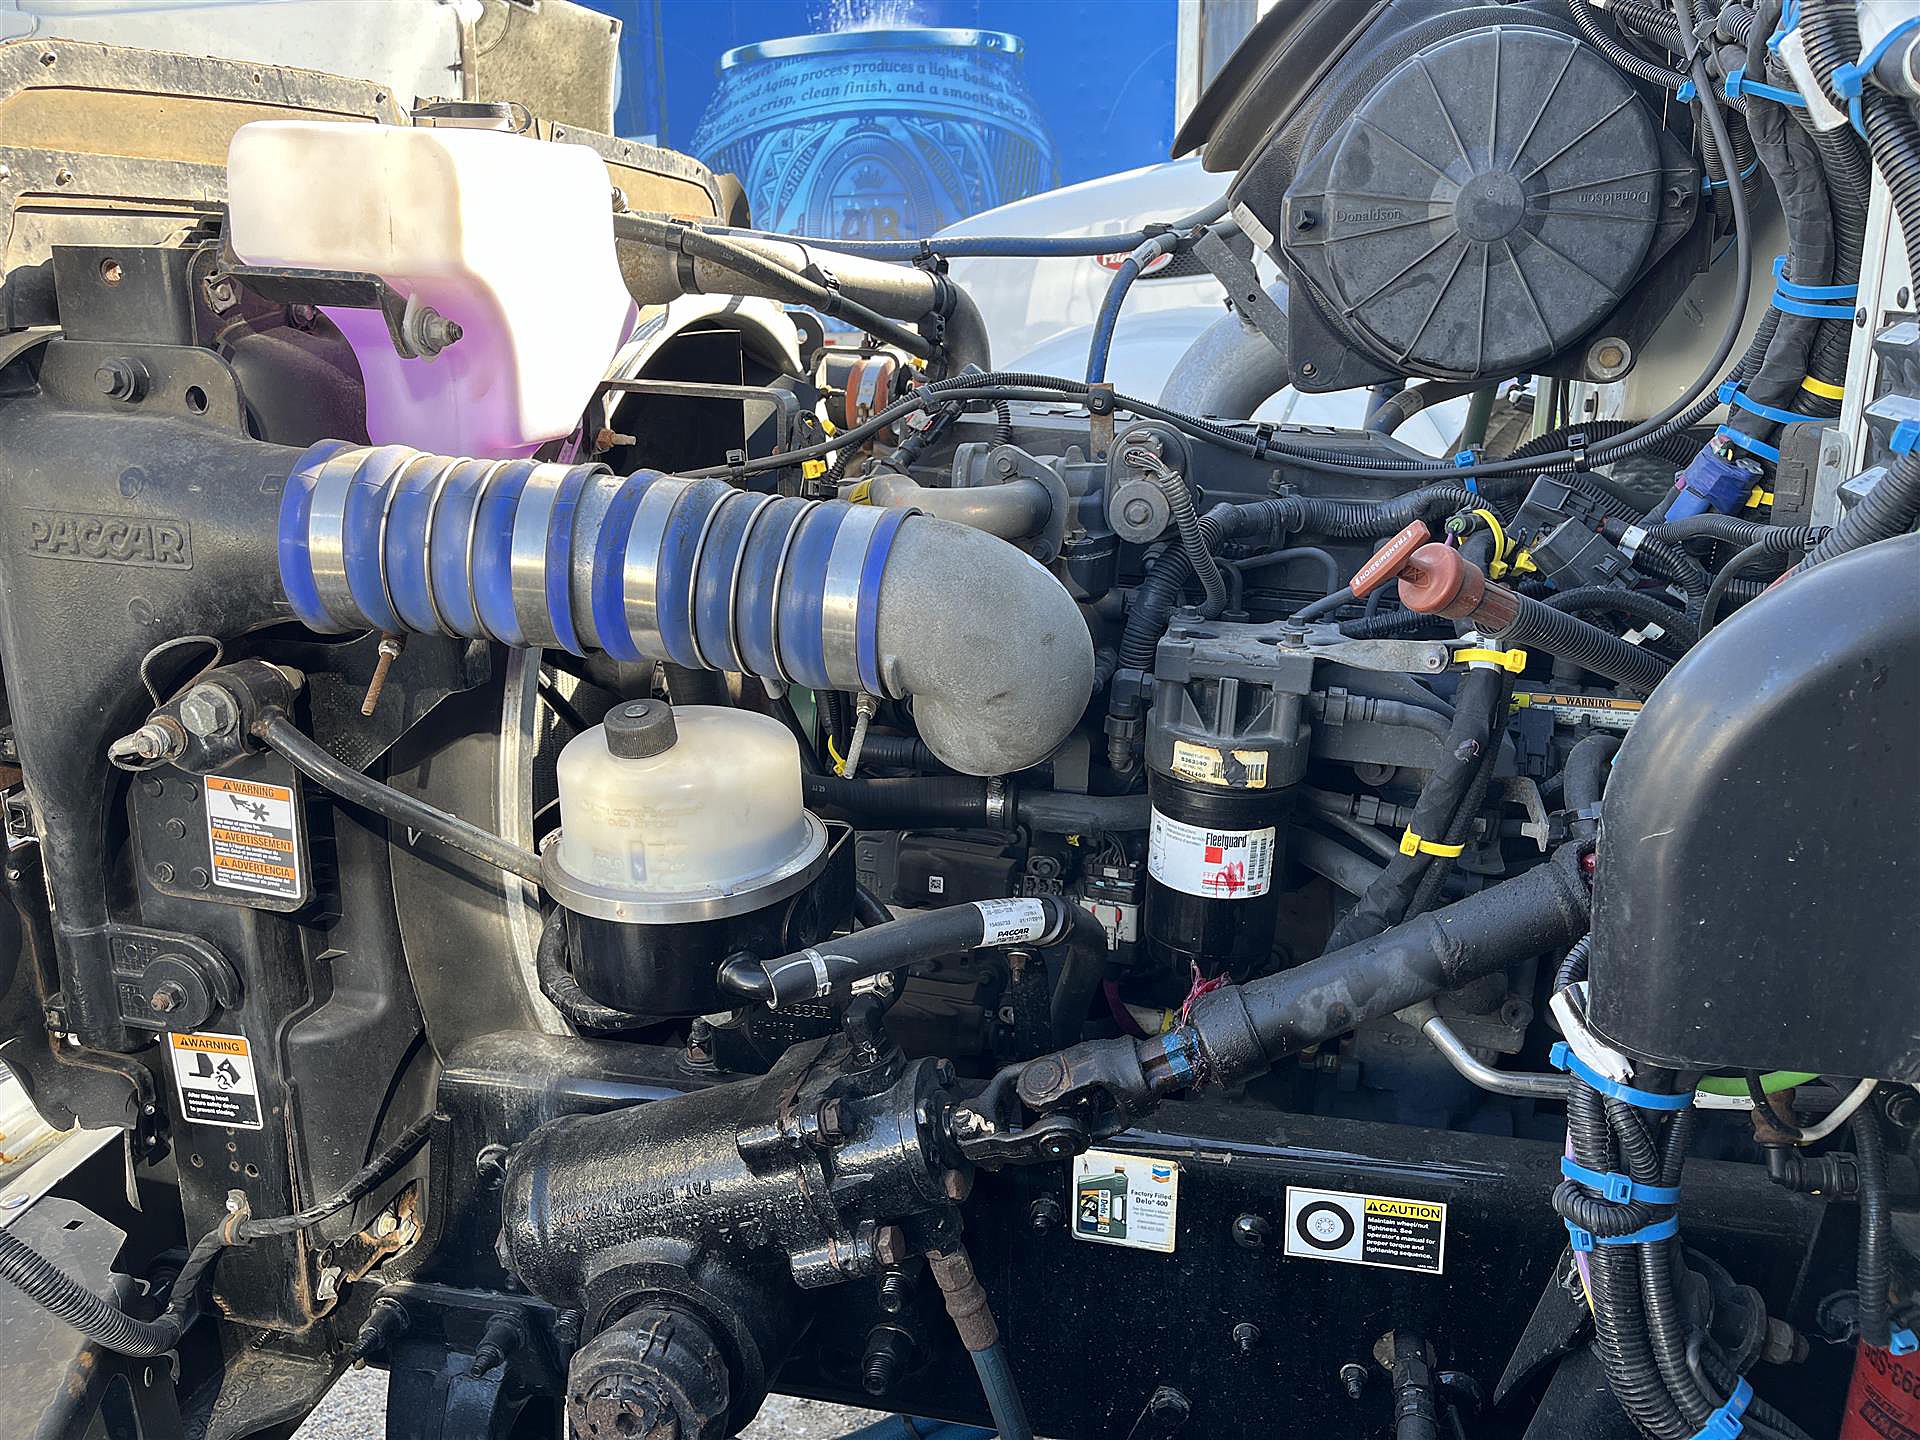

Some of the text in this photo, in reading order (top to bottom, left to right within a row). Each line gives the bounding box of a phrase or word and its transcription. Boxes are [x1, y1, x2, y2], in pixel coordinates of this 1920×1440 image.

[762, 75, 798, 95] Aging
[802, 64, 849, 84] process
[852, 58, 914, 76] produces
[917, 64, 926, 74] a
[759, 95, 796, 112] crisp,
[802, 86, 840, 101] clean
[843, 80, 892, 97] finish,
[896, 82, 925, 94] and
[929, 86, 938, 96] a
[943, 88, 994, 107] smooth
[779, 145, 818, 207] AUSTRALIA
[1577, 190, 1650, 204] Donaldson
[1335, 208, 1401, 223] Donaldson
[31, 518, 185, 564] PACCAR
[1360, 536, 1408, 582] TRANSMISSION
[1566, 697, 1612, 708] WARNING
[232, 782, 275, 798] WARNING
[225, 832, 292, 850] AVERTISSEMENT
[1206, 832, 1248, 850] Fleetguard
[231, 860, 290, 877] ADVERTENCIA
[997, 927, 1030, 937] PACCAR
[188, 1038, 240, 1051] WARNING
[1131, 1190, 1172, 1200] Factory Filled
[1156, 1199, 1168, 1207] 400
[1379, 1203, 1440, 1218] CAUTION
[1367, 1217, 1395, 1225] Maintain
[1367, 1224, 1398, 1233] tightness.
[1367, 1232, 1400, 1240] operator's
[1366, 1239, 1388, 1247] proper
[1389, 1241, 1410, 1249] torque
[1366, 1247, 1432, 1259] tightening sequence.
